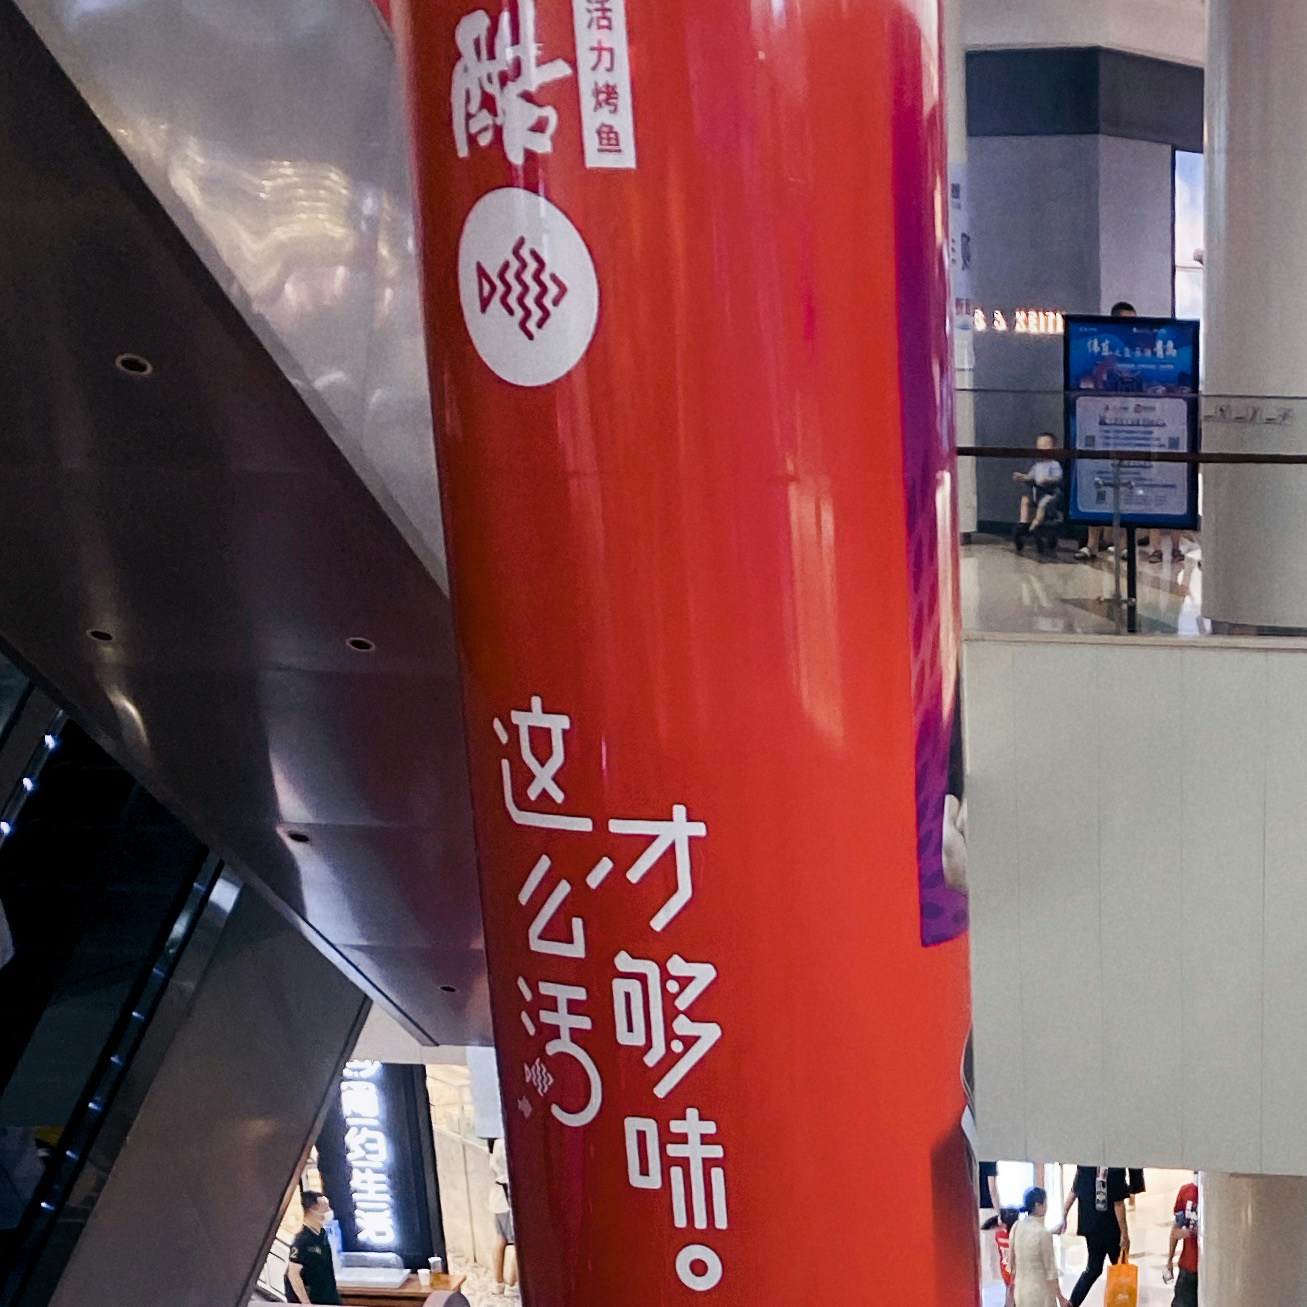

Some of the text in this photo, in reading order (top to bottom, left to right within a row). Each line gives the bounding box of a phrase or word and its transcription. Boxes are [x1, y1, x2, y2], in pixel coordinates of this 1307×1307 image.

[585, 0, 622, 153] 活力烤鱼
[494, 697, 613, 1127] 这么活
[608, 804, 728, 1292] 才够味。
